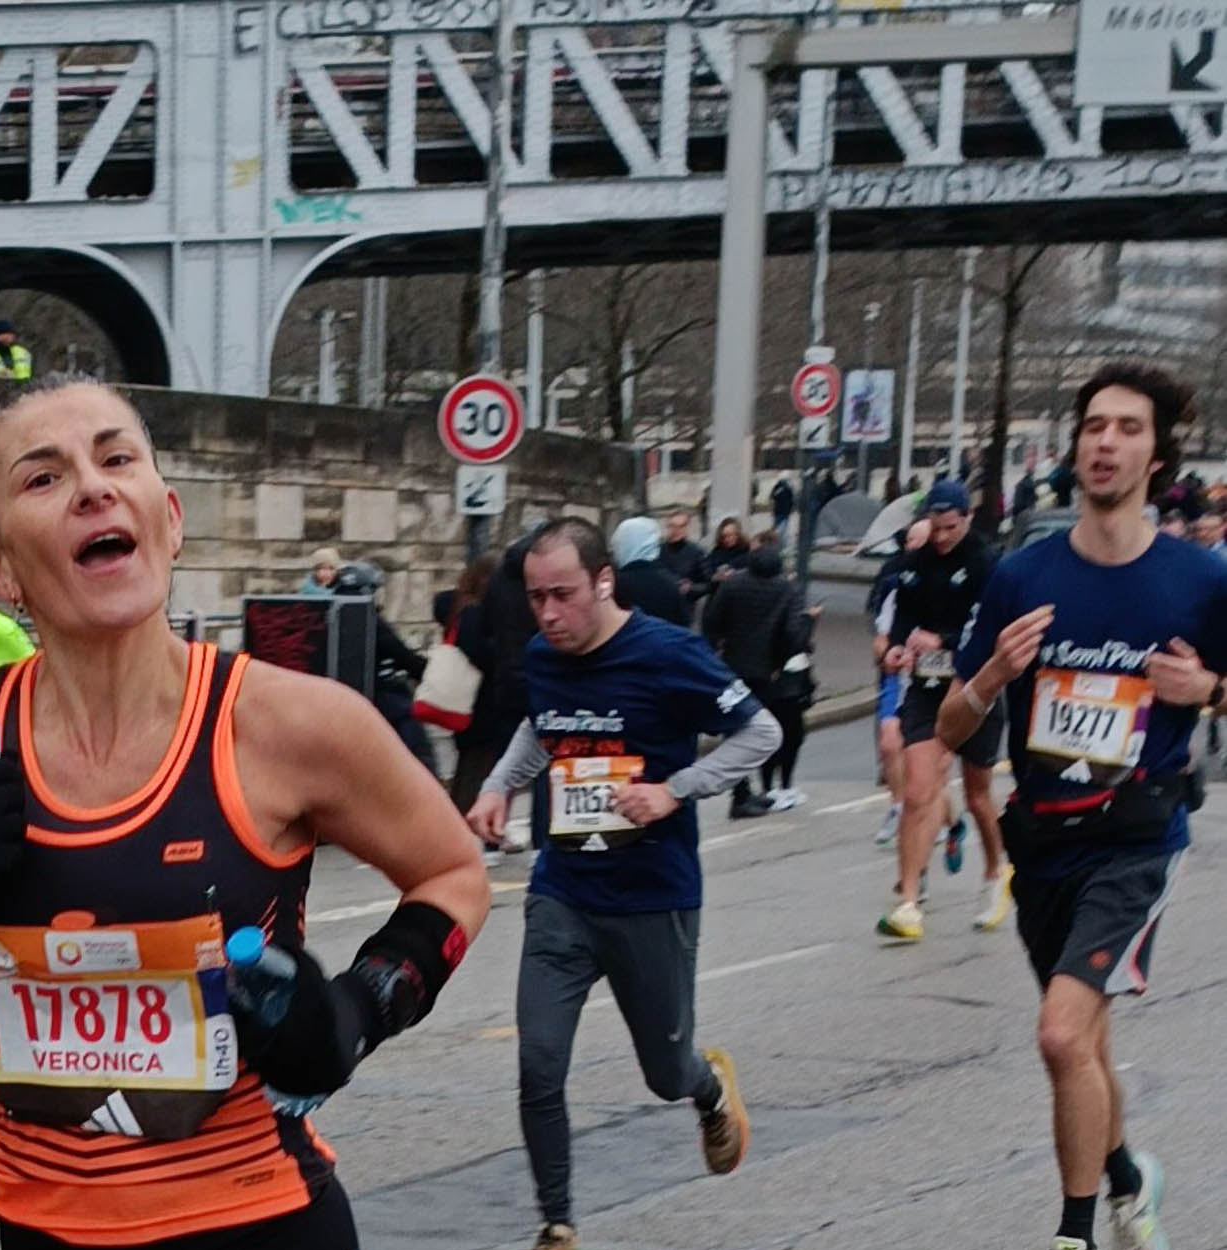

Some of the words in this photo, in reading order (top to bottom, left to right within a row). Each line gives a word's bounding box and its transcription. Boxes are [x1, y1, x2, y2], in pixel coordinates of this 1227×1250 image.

[459, 402, 505, 436] 30
[1048, 698, 1119, 741] 19277
[12, 983, 171, 1044] 17878
[32, 1050, 164, 1072] VERONICA
